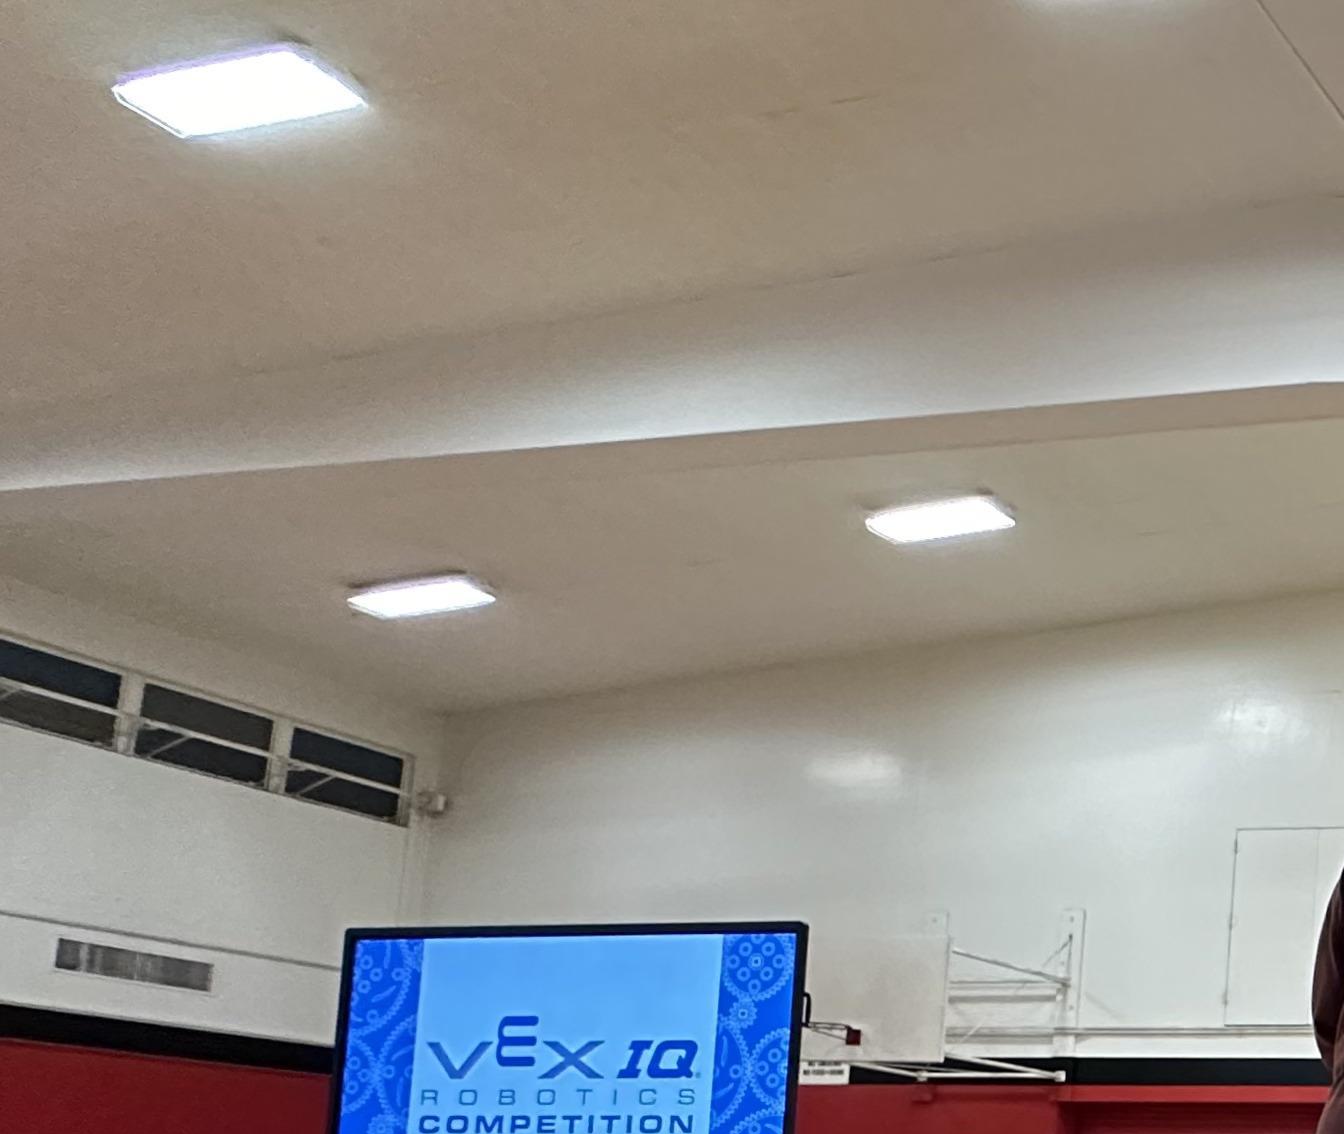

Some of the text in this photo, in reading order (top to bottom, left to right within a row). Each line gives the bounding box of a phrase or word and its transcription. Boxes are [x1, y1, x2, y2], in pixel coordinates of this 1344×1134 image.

[427, 1015, 699, 1080] VEX IQ
[421, 1088, 695, 1106] ROBOTICS
[418, 1114, 694, 1134] COMPETITION
